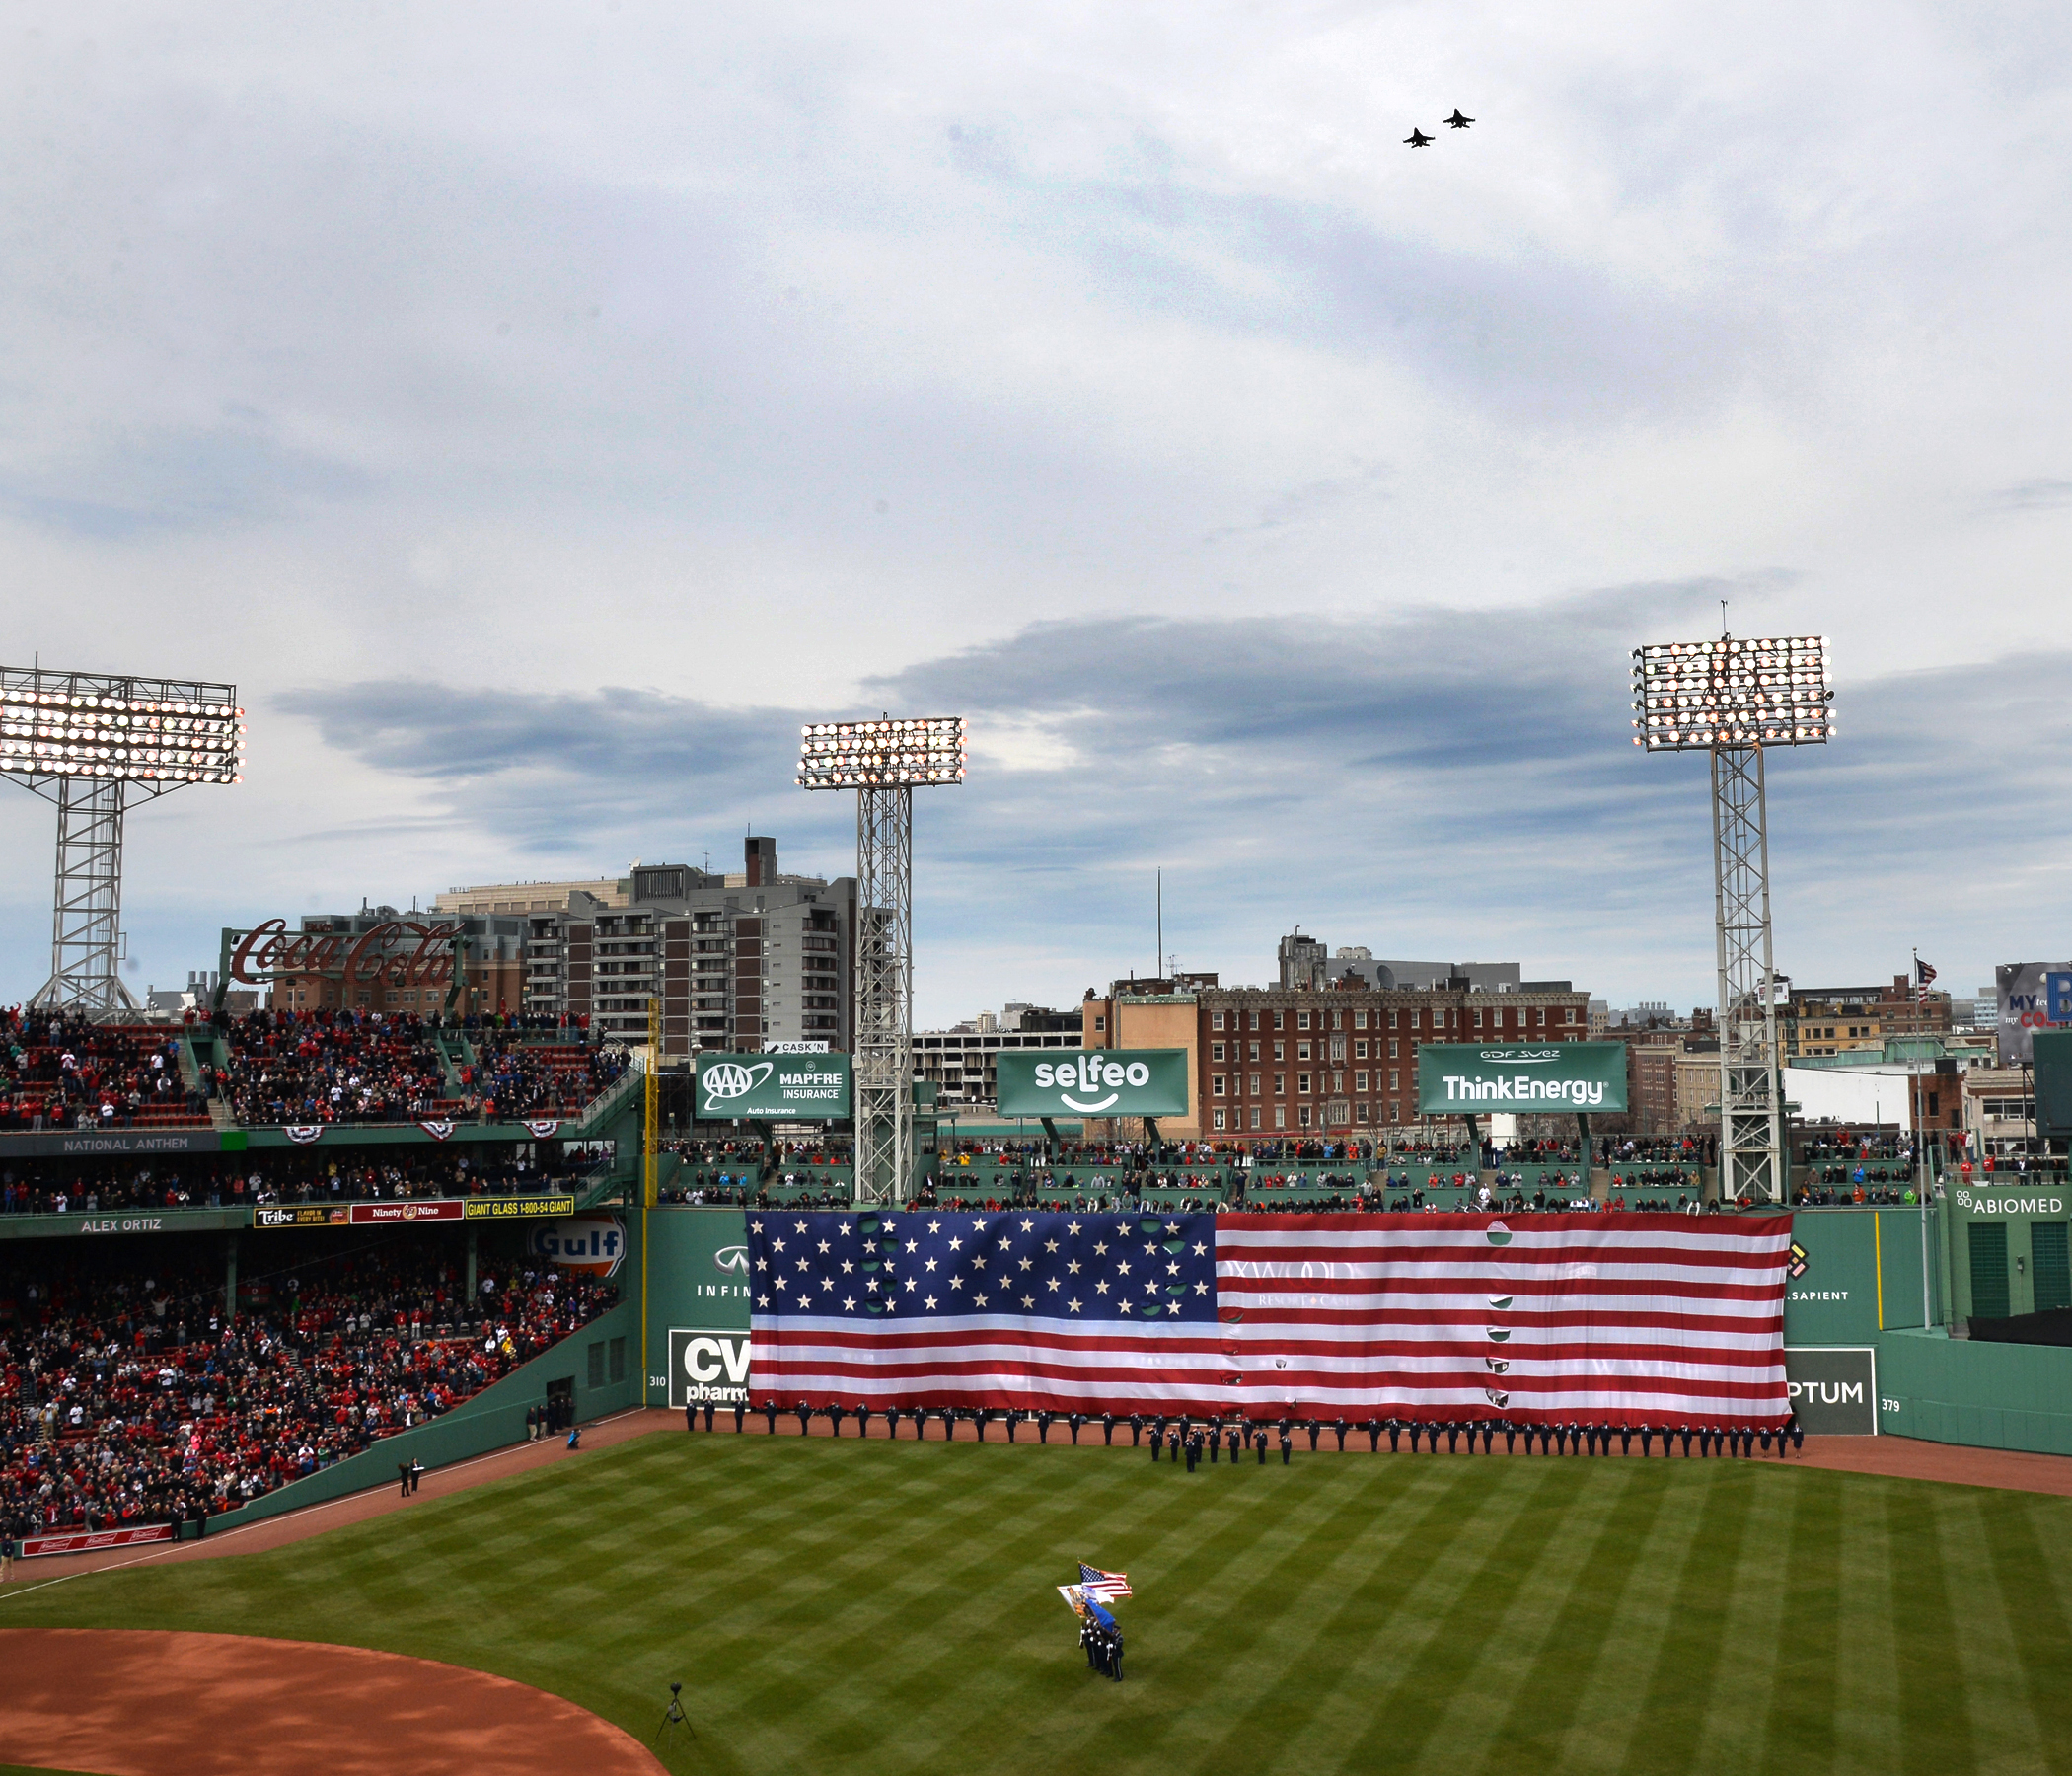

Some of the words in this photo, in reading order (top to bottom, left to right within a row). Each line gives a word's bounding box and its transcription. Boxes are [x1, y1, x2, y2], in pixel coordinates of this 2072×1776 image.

[232, 918, 466, 986] Coca-Cola
[2009, 995, 2036, 1011] MY
[782, 1043, 811, 1052] CASK
[707, 1064, 748, 1096] AAA
[779, 1073, 843, 1085] MAPFRE
[783, 1089, 839, 1099] INSURANCE
[1443, 1075, 1603, 1105] ThinkEnergy
[64, 1139, 130, 1151] NATIONAL
[136, 1138, 188, 1149] ANTHEM
[372, 1208, 403, 1219] Ninety
[417, 1206, 439, 1216] Nine
[468, 1203, 491, 1216] GIANT
[492, 1202, 519, 1215] GLASS
[520, 1201, 549, 1214] 1-800-54
[550, 1200, 571, 1213] GIANT
[1973, 1198, 2063, 1214] ABIOMED
[258, 1208, 294, 1225] Tribe
[81, 1220, 117, 1232] ALEX
[123, 1219, 162, 1231] ORTIZ
[535, 1227, 619, 1257] Gulf
[697, 1285, 751, 1297] INFIN
[684, 1337, 751, 1383] CV
[649, 1376, 666, 1387] 310
[686, 1382, 750, 1404] pharm
[1788, 1382, 1863, 1404] PTUM
[1882, 1398, 1900, 1412] 379
